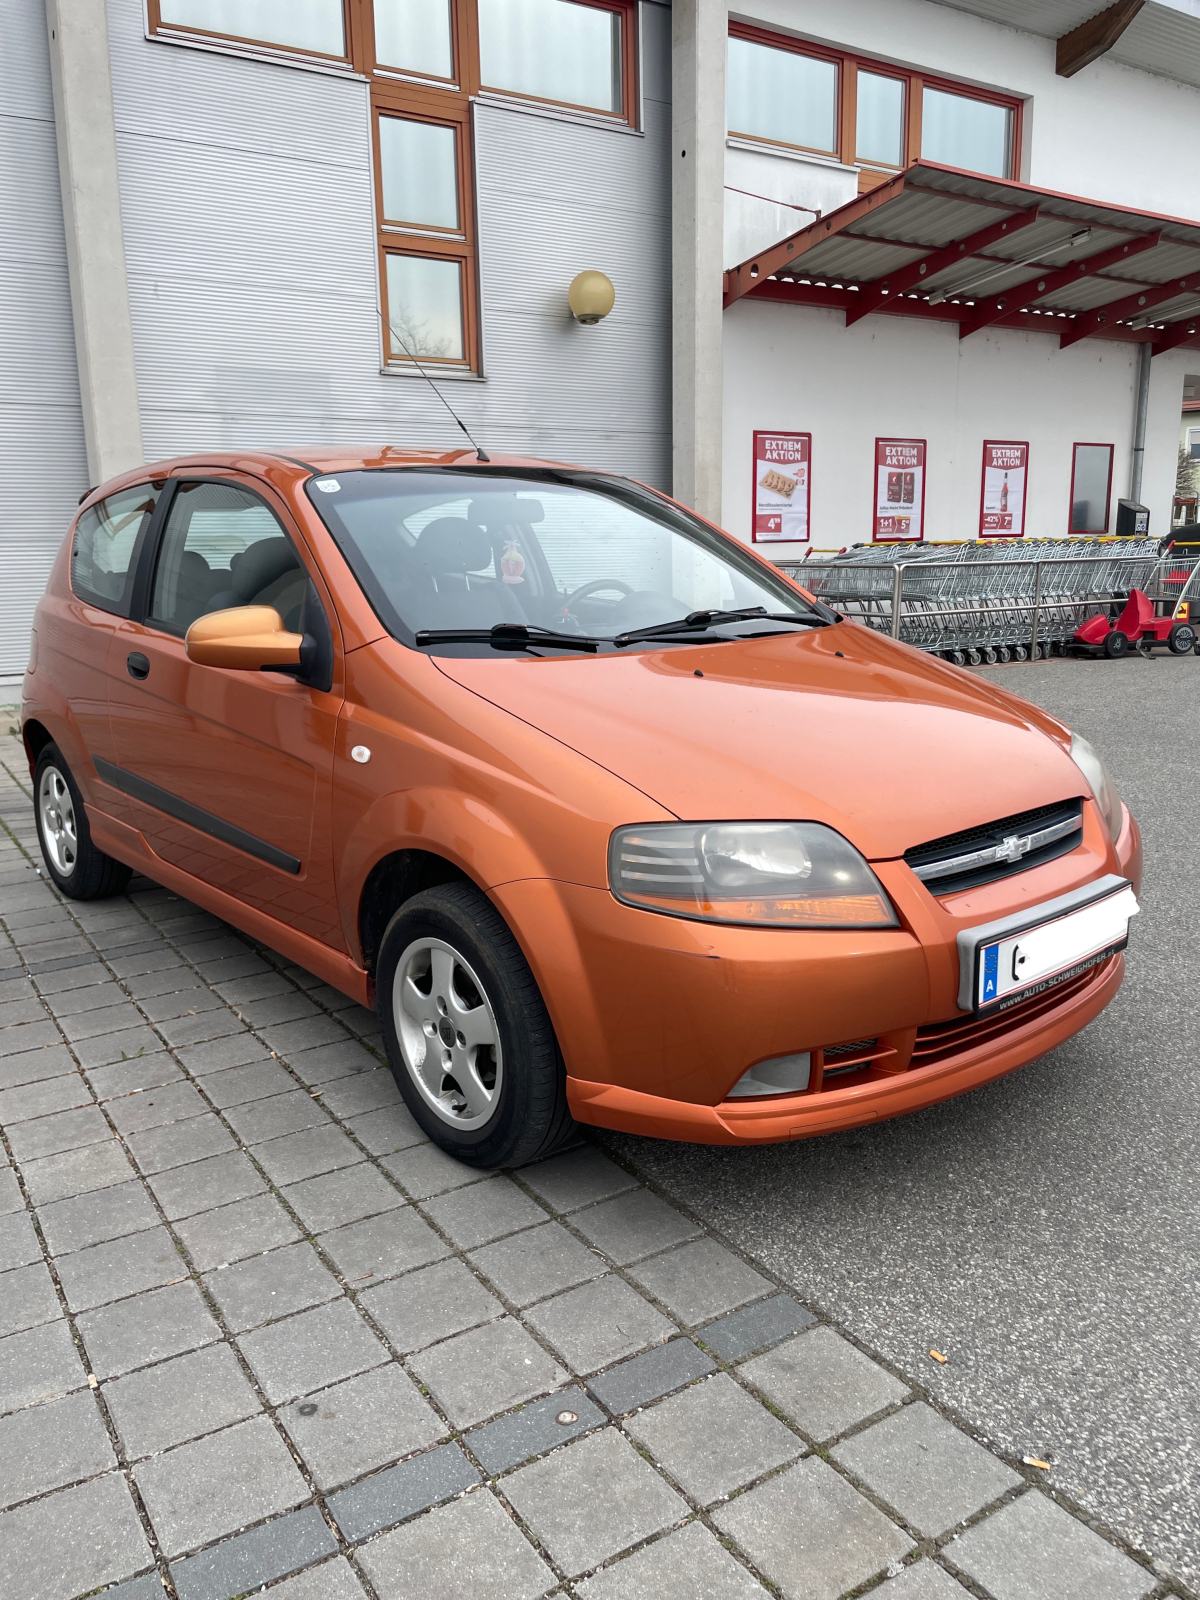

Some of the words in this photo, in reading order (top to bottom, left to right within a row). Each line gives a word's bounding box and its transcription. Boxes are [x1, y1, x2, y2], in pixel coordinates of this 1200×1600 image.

[765, 440, 801, 450] EXTREM
[765, 451, 801, 460] AKTION
[886, 447, 917, 456] EXTREM
[886, 457, 917, 465] AKTION
[992, 458, 1020, 466] AKTION
[880, 518, 892, 527] 1+1
[986, 980, 993, 992] A
